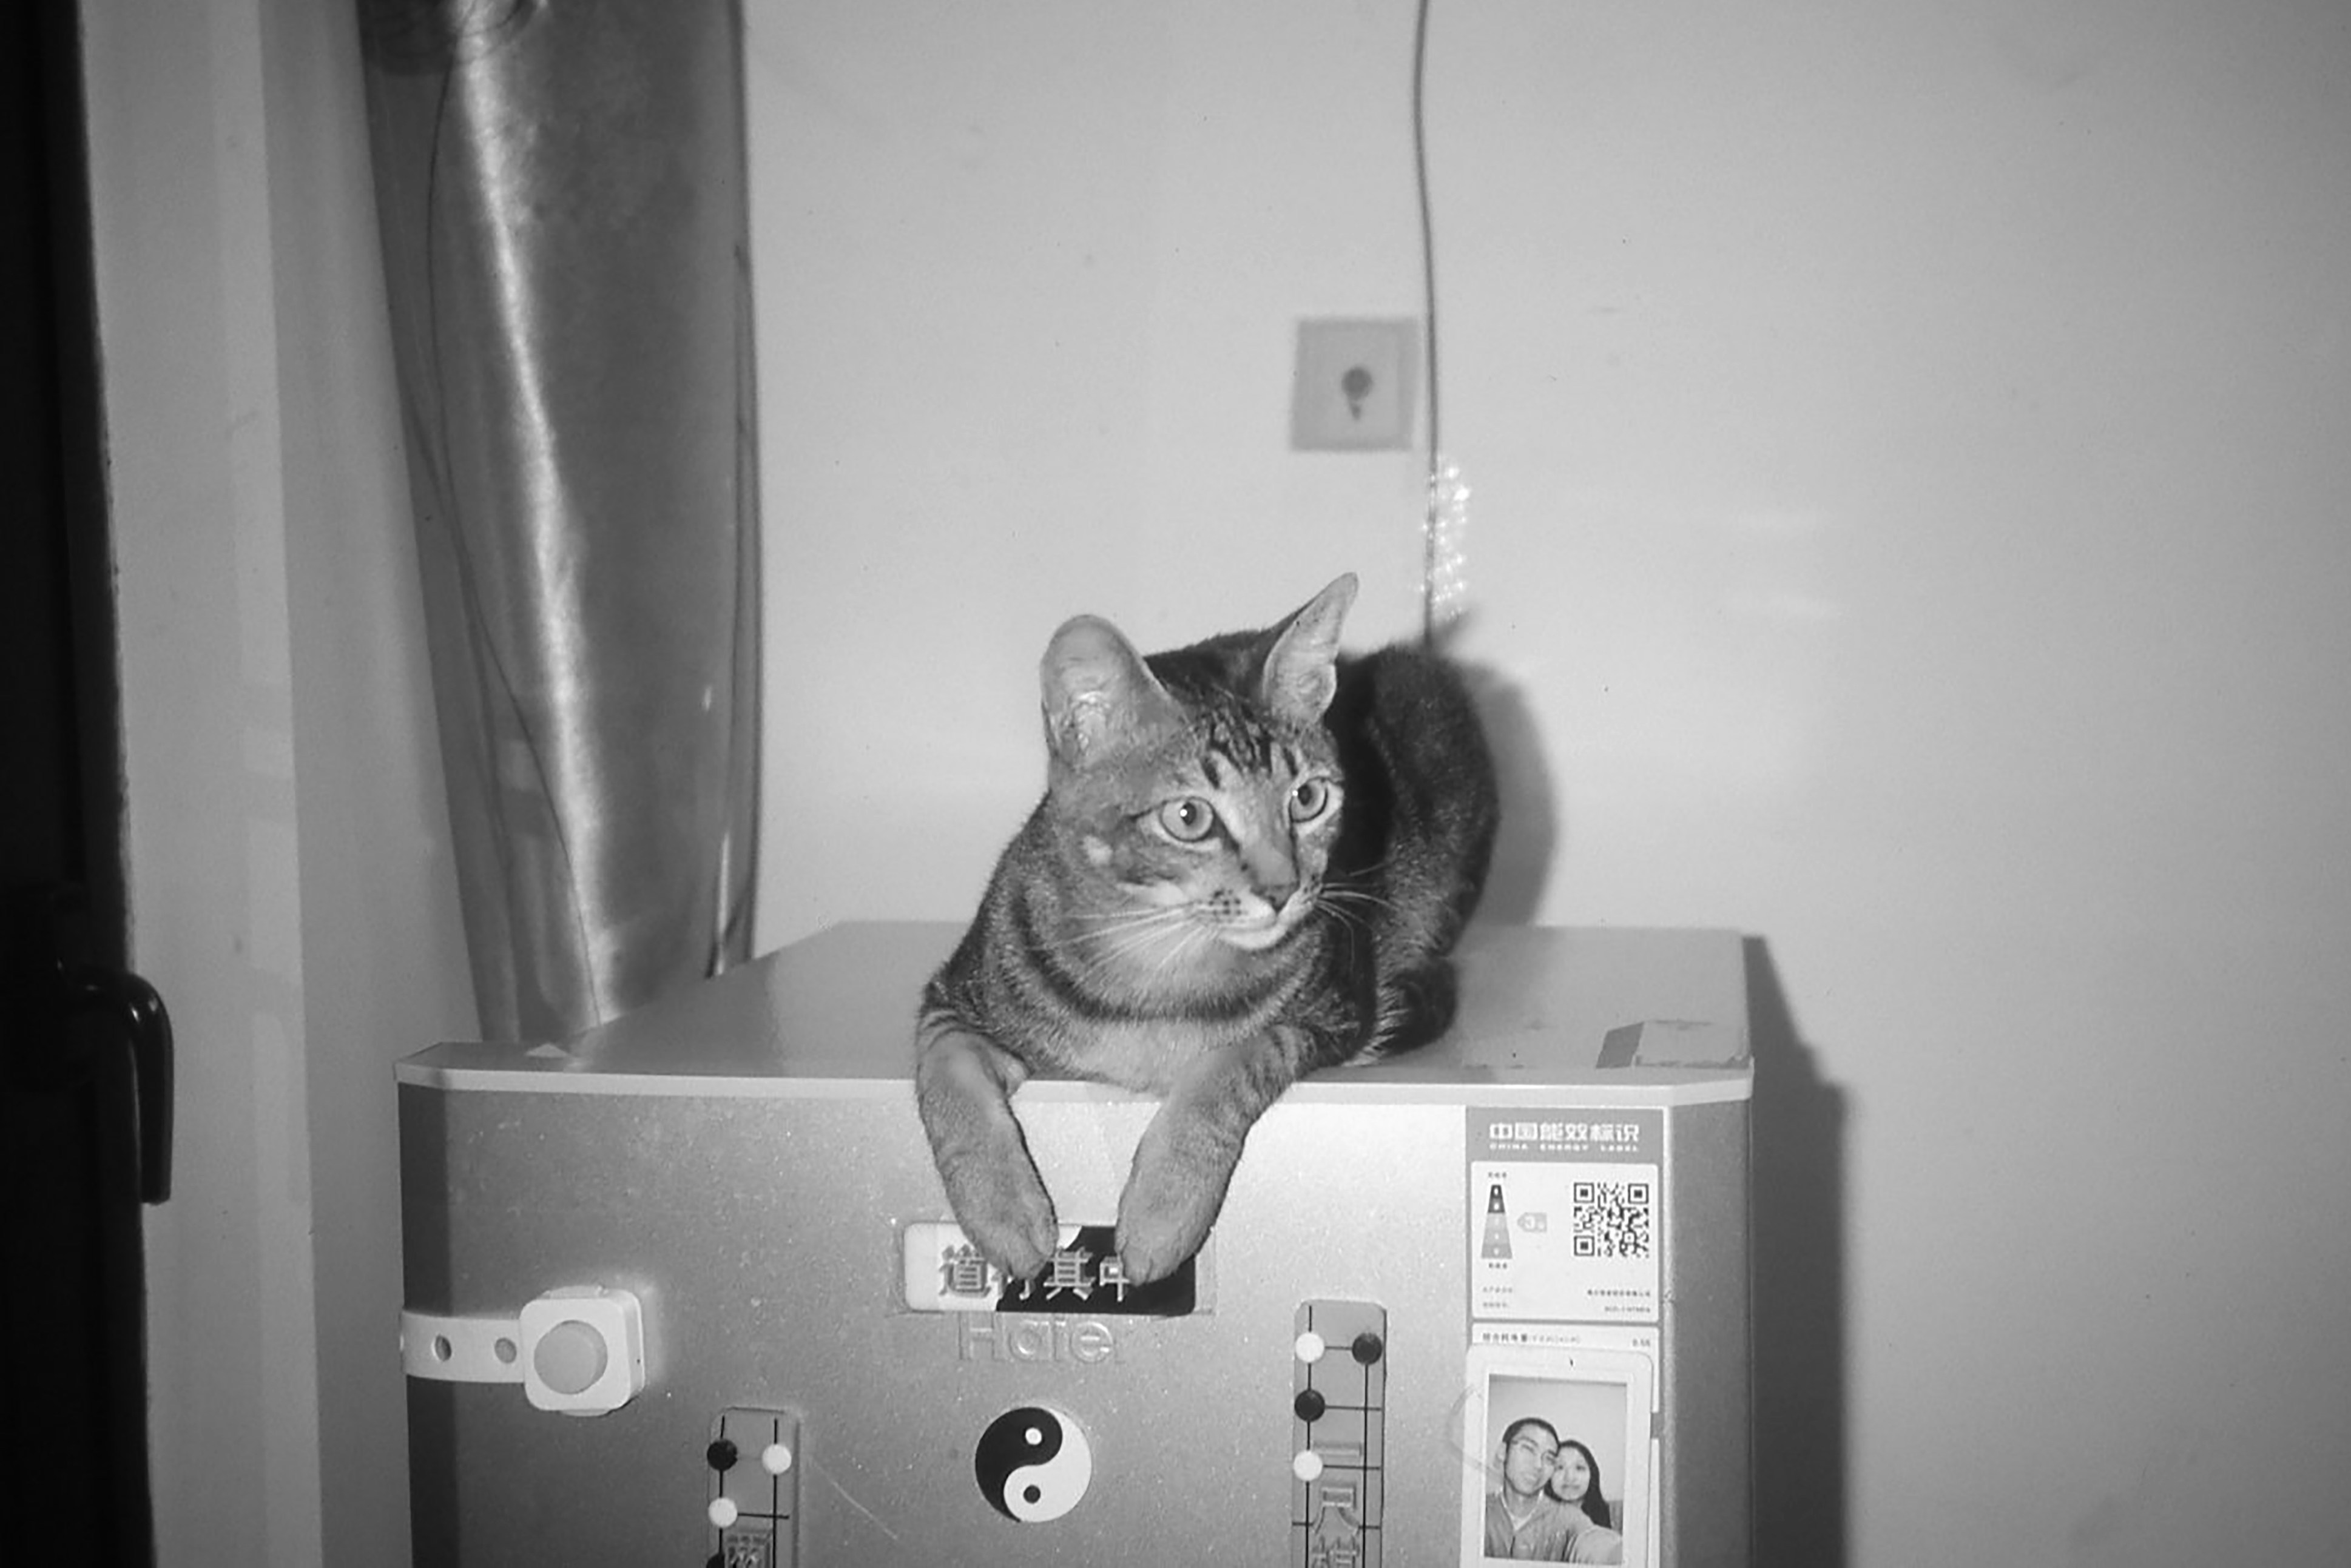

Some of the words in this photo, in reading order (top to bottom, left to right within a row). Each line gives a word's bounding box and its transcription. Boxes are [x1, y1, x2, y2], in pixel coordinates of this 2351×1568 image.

[1489, 1122, 1639, 1142] 中国能效标识
[938, 1243, 1131, 1302] 道其中
